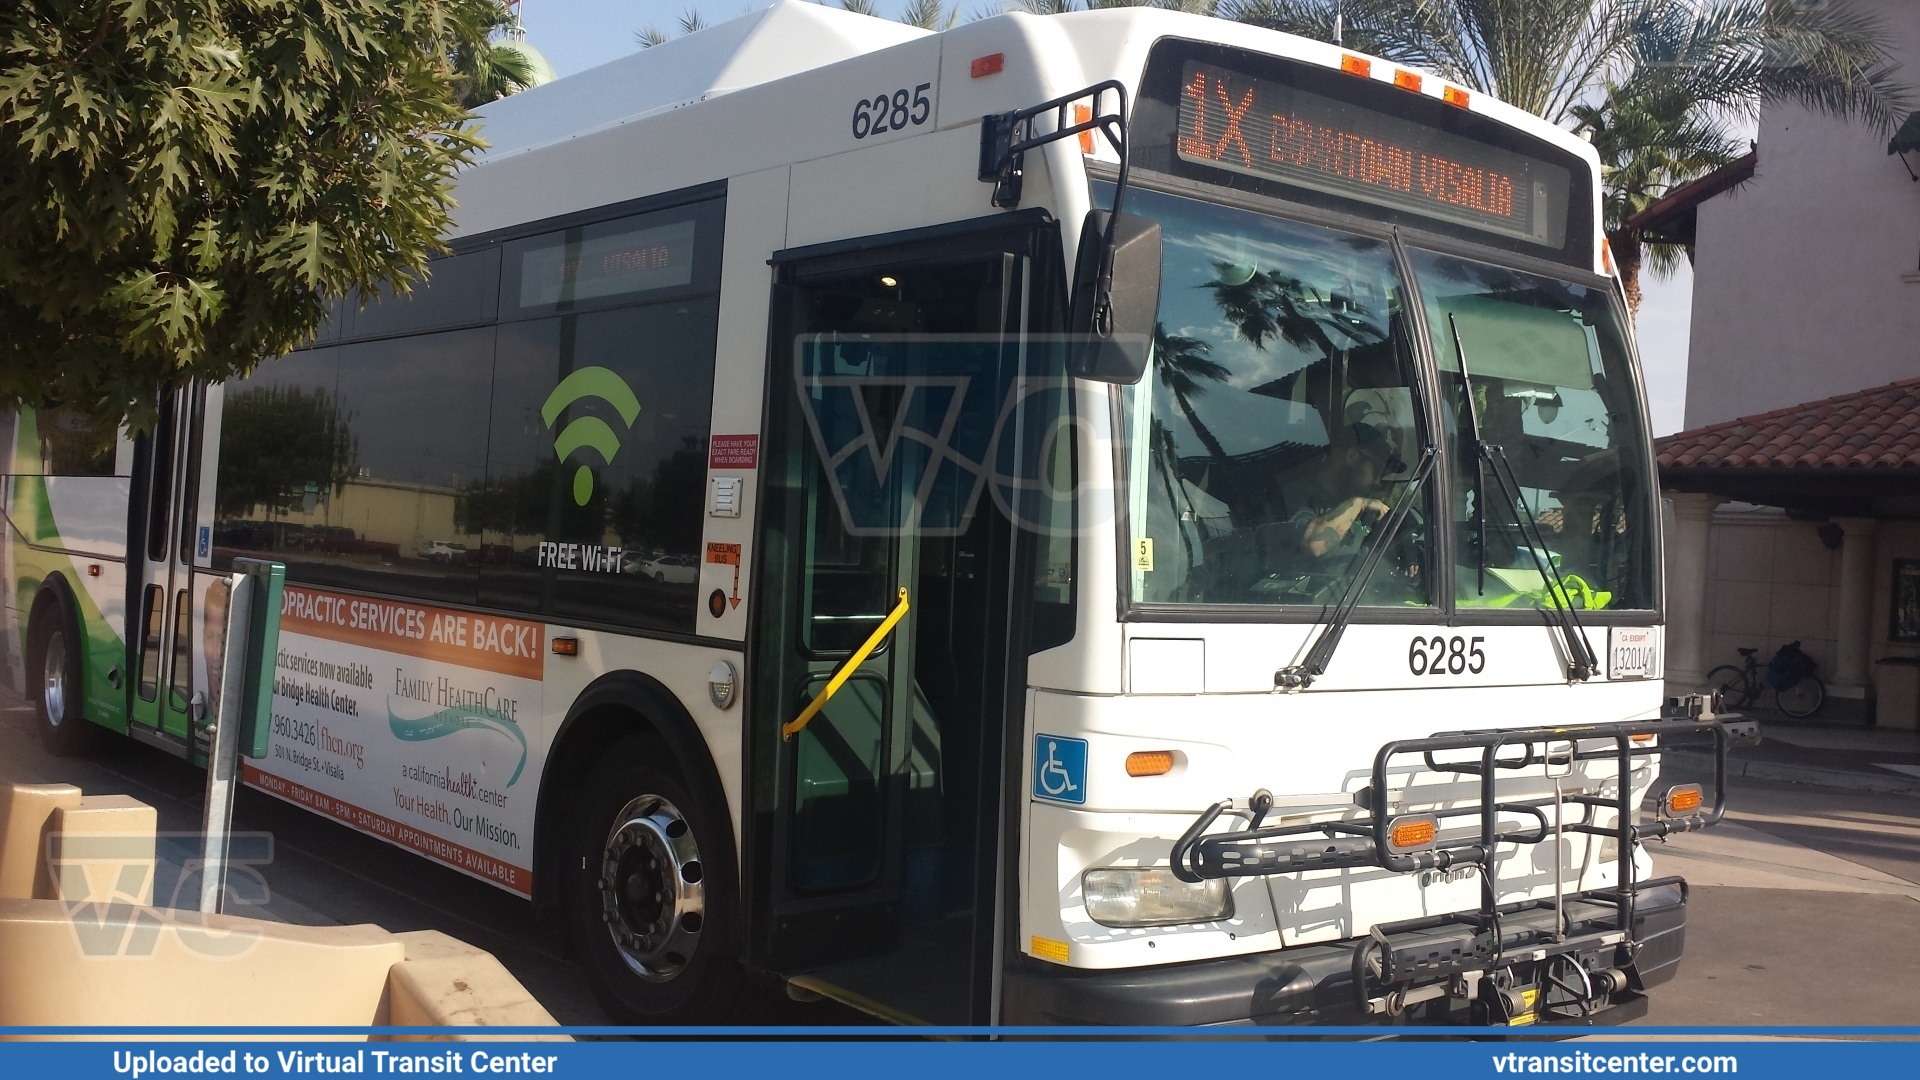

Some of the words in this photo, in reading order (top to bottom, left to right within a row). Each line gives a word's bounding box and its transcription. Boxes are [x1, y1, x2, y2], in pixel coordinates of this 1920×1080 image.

[852, 82, 931, 140] 6285
[1177, 72, 1254, 168] 1X
[1421, 155, 1512, 216] VISALIA
[538, 541, 578, 570] FREE
[581, 544, 621, 573] Wi-Fi
[707, 543, 736, 553] KNEELING
[714, 554, 727, 564] BUS
[1140, 541, 1146, 555] 5
[349, 600, 425, 640] SERVICES
[430, 613, 467, 647] ARE
[473, 619, 537, 659] BACK!
[290, 652, 318, 676] services
[319, 661, 336, 680] now
[337, 662, 373, 689] available
[1408, 635, 1485, 676] 6285
[281, 676, 304, 706] Bridge
[305, 682, 329, 709] Health
[331, 689, 359, 717] Center.
[395, 667, 434, 703] FAMILY
[270, 713, 315, 746] .960.3426
[321, 726, 364, 769] fhcn.org
[275, 744, 285, 759] 501
[293, 749, 312, 771] Bridge
[312, 757, 320, 772] St.
[324, 760, 344, 780] Visalia
[402, 765, 407, 777] a
[259, 773, 285, 792] MONDAY
[291, 786, 313, 805] FRIDAY
[315, 795, 330, 811] 8AM
[336, 803, 350, 818] 5PM
[358, 811, 396, 837] SATURDAY
[398, 827, 463, 863] APPOINTMENTS
[466, 853, 515, 884] AVAILABLE
[393, 787, 415, 811] Your
[416, 795, 451, 825] Health.
[453, 808, 473, 832] Our
[475, 815, 520, 850] Mission.
